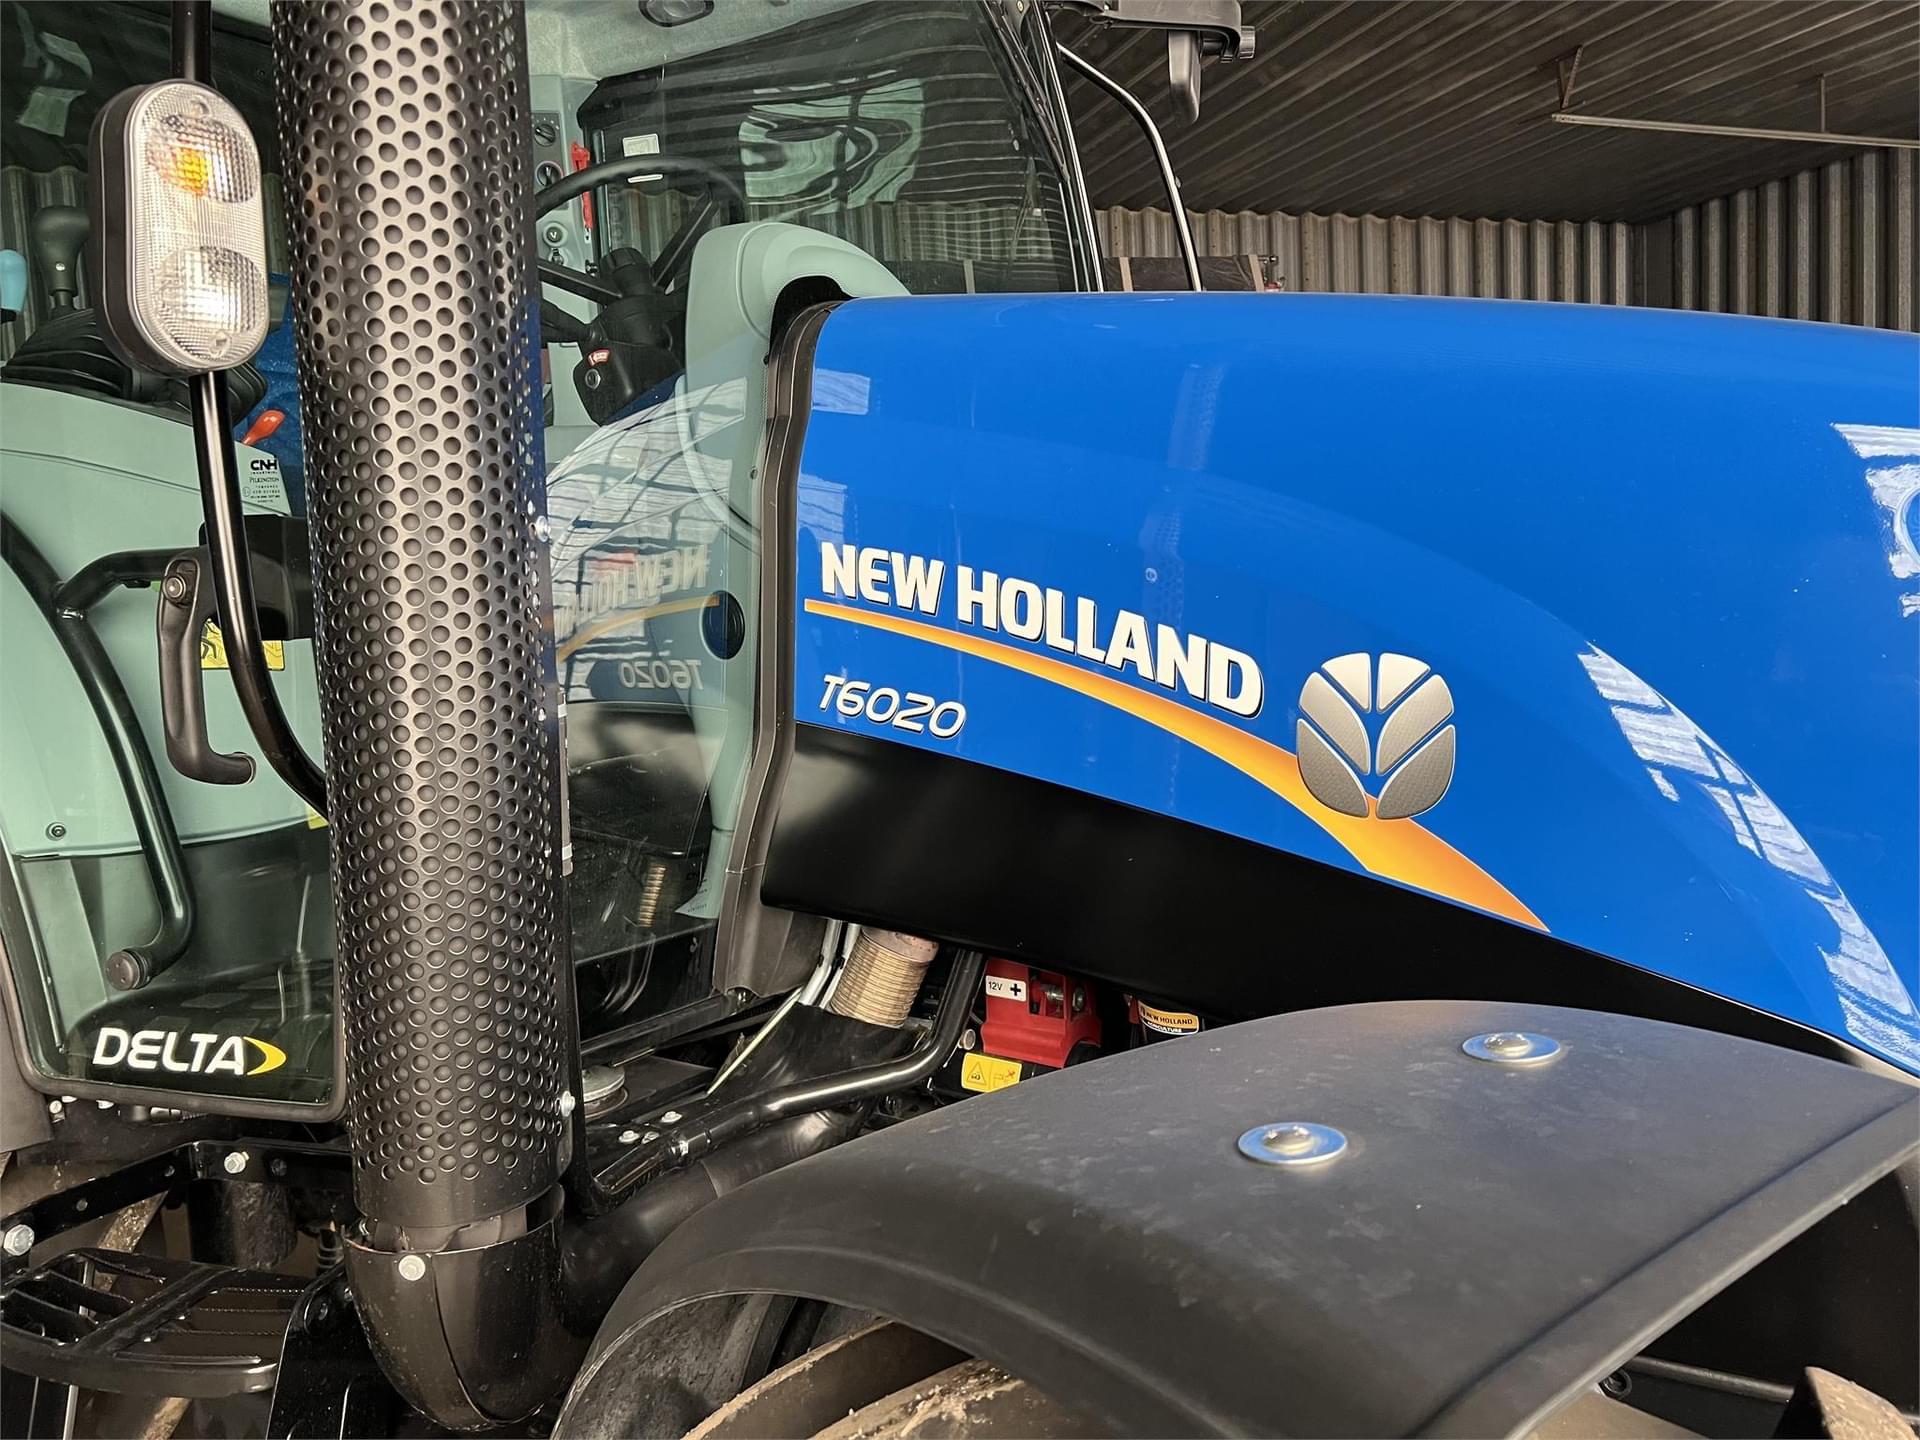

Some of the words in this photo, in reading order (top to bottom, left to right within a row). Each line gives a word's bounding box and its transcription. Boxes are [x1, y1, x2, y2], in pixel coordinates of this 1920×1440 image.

[251, 460, 277, 470] CNH
[820, 541, 944, 616] NEW
[956, 564, 1264, 719] HOLLAND
[819, 674, 967, 739] T6020
[988, 981, 1002, 991] 12V
[1160, 1016, 1193, 1025] HOLLAND
[92, 1027, 244, 1076] DELTA
